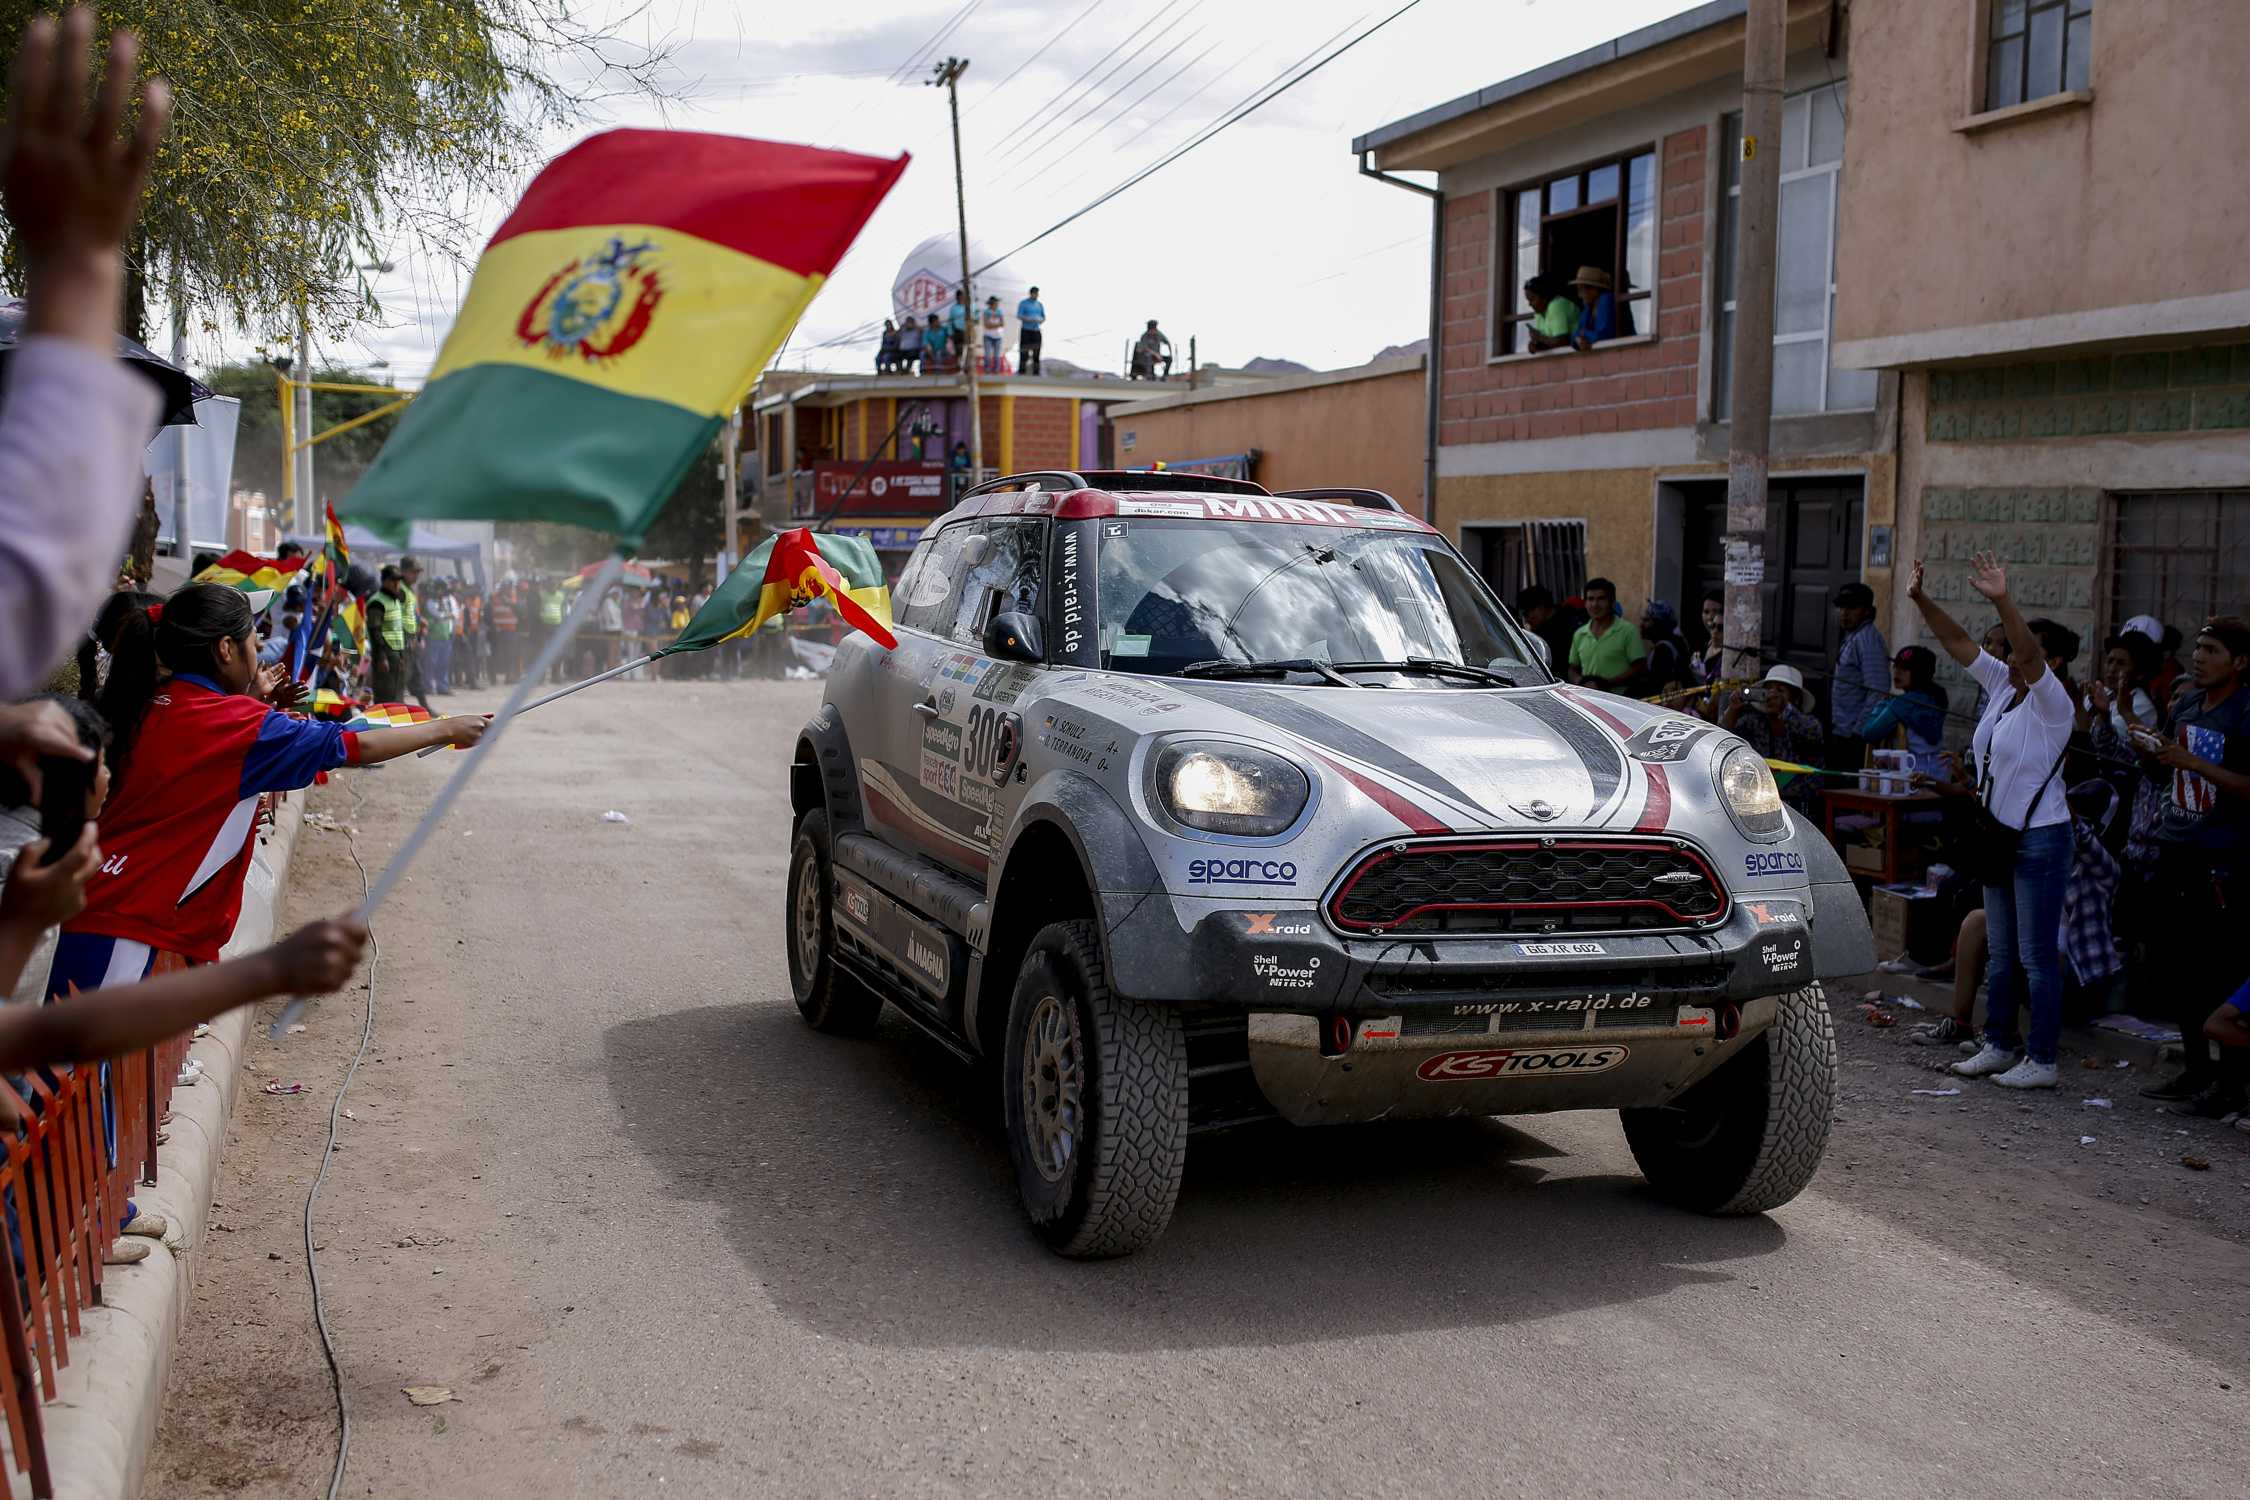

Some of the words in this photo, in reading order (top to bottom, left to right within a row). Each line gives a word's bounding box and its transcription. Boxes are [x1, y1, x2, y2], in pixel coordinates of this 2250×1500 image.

[1204, 498, 1346, 523] MINI
[1064, 531, 1082, 653] www.x-raid.de
[1189, 860, 1297, 885] sparco
[1745, 853, 1802, 877] sparco
[1244, 913, 1311, 934] X-raid
[1749, 904, 1797, 924] X-raid
[1253, 955, 1277, 964] Shell
[1526, 944, 1549, 955] GG
[1549, 944, 1570, 953] XR
[1573, 944, 1600, 953] 602
[1762, 944, 1777, 954] Shell
[1762, 951, 1799, 965] V-Power
[915, 941, 944, 983] MAGNA
[1254, 965, 1316, 978] V-Power
[1454, 992, 1651, 1015] www.x-raid.de
[1428, 1055, 1507, 1077] KS
[1505, 1051, 1614, 1071] TOOLS
